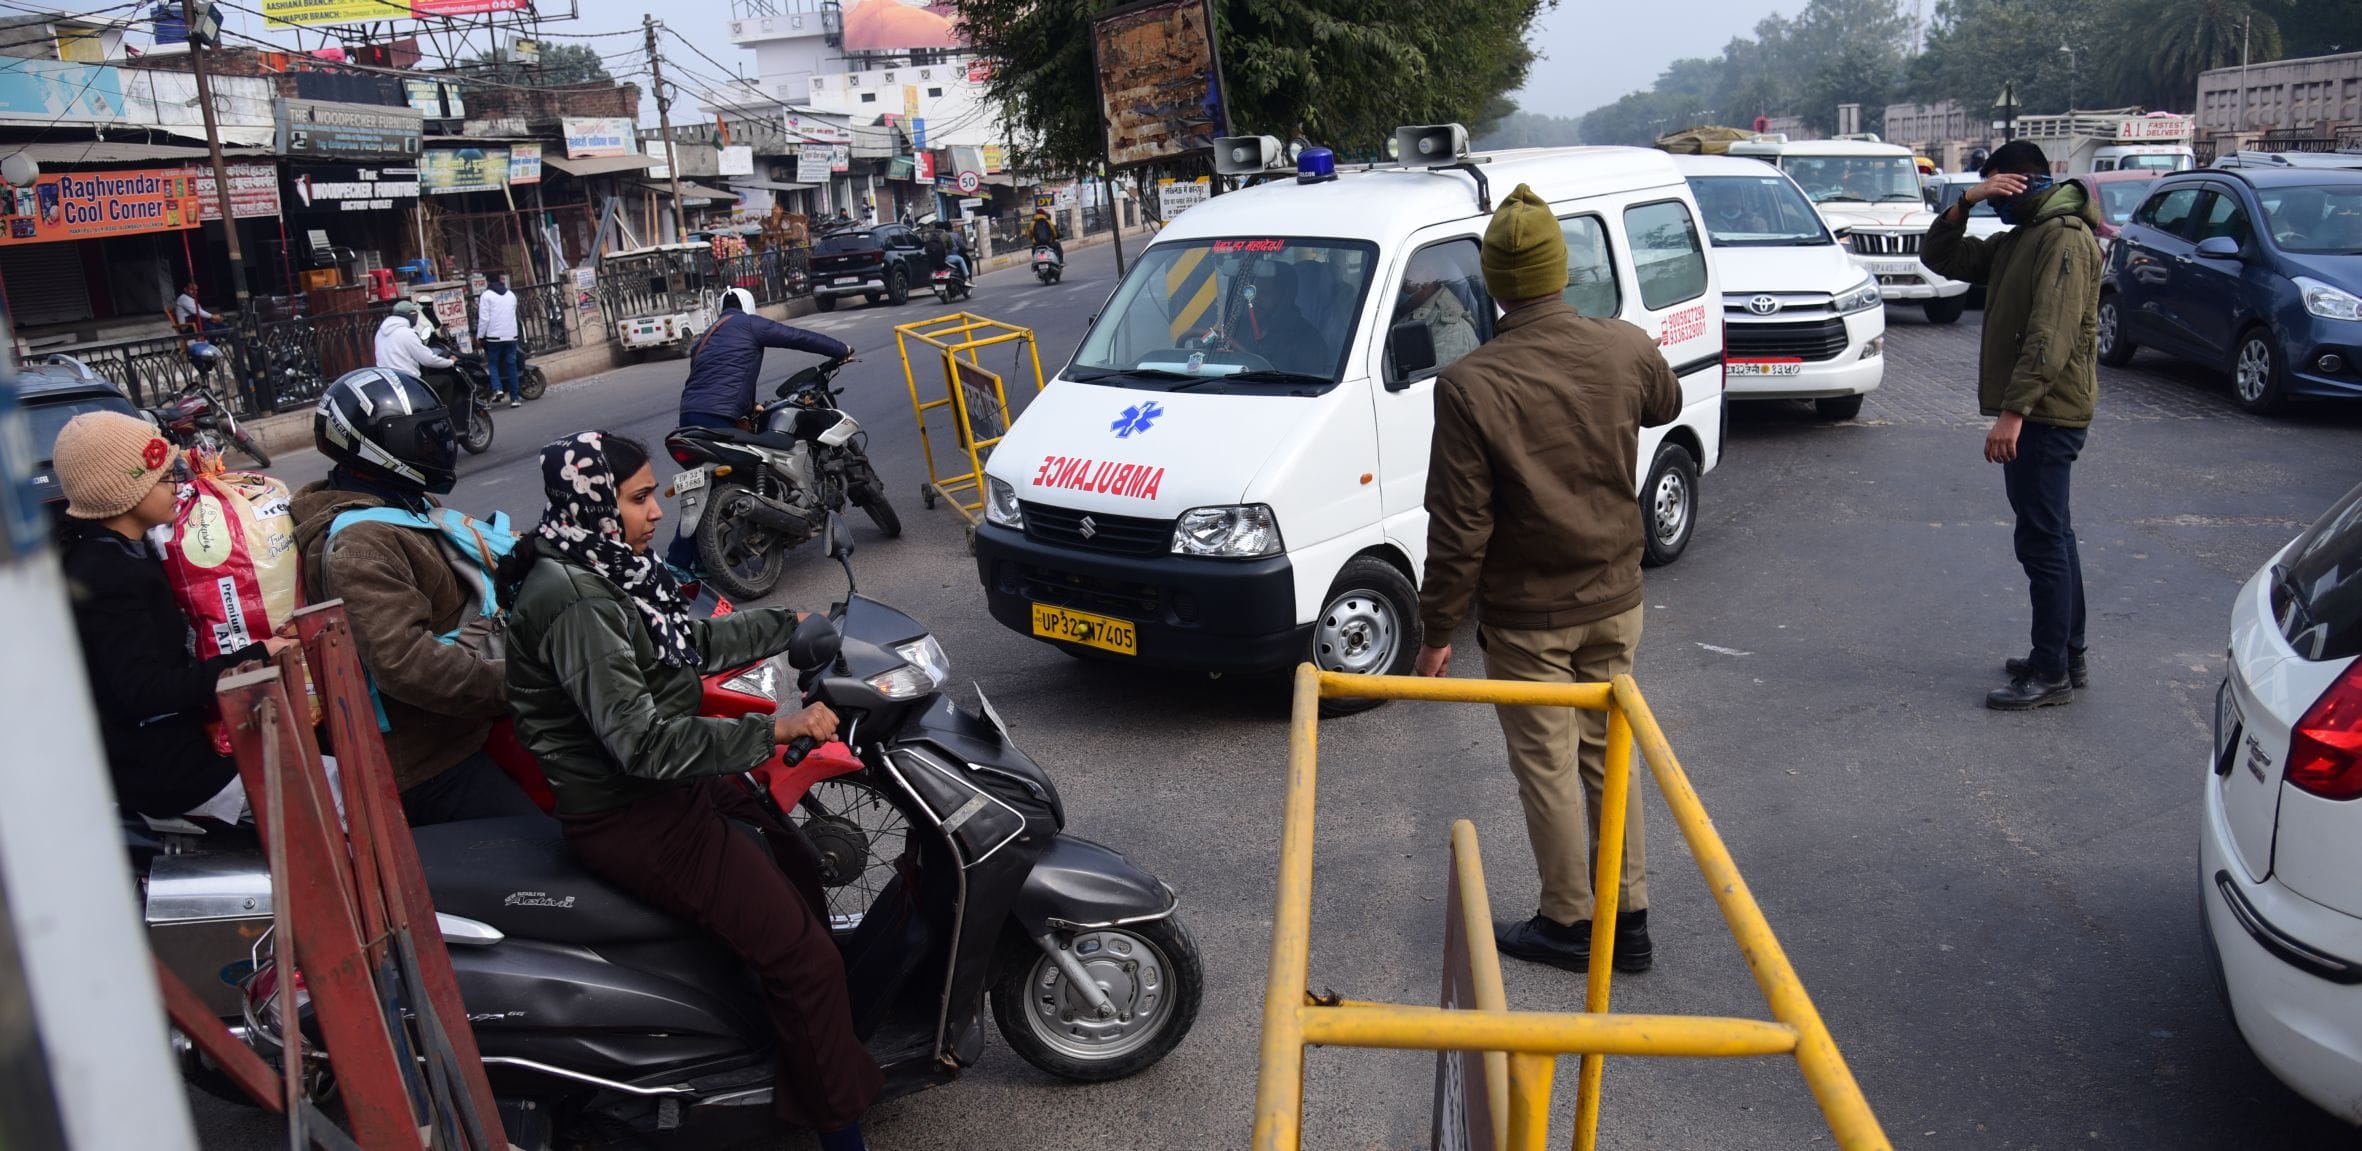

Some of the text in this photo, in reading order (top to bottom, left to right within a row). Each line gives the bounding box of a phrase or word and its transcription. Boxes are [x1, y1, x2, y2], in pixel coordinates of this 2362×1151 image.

[290, 109, 420, 130] THE WOODPECKER FURNITURE
[2148, 121, 2185, 129] FASTEST
[2146, 128, 2185, 136] DELIVERY
[61, 174, 161, 202] Raghvendar
[311, 182, 420, 199] WOODPECKER FURNITURE
[962, 177, 975, 188] 50
[63, 200, 163, 225] Cool Corner
[221, 583, 242, 635] Premium
[1043, 611, 1133, 649] UP32N7405
